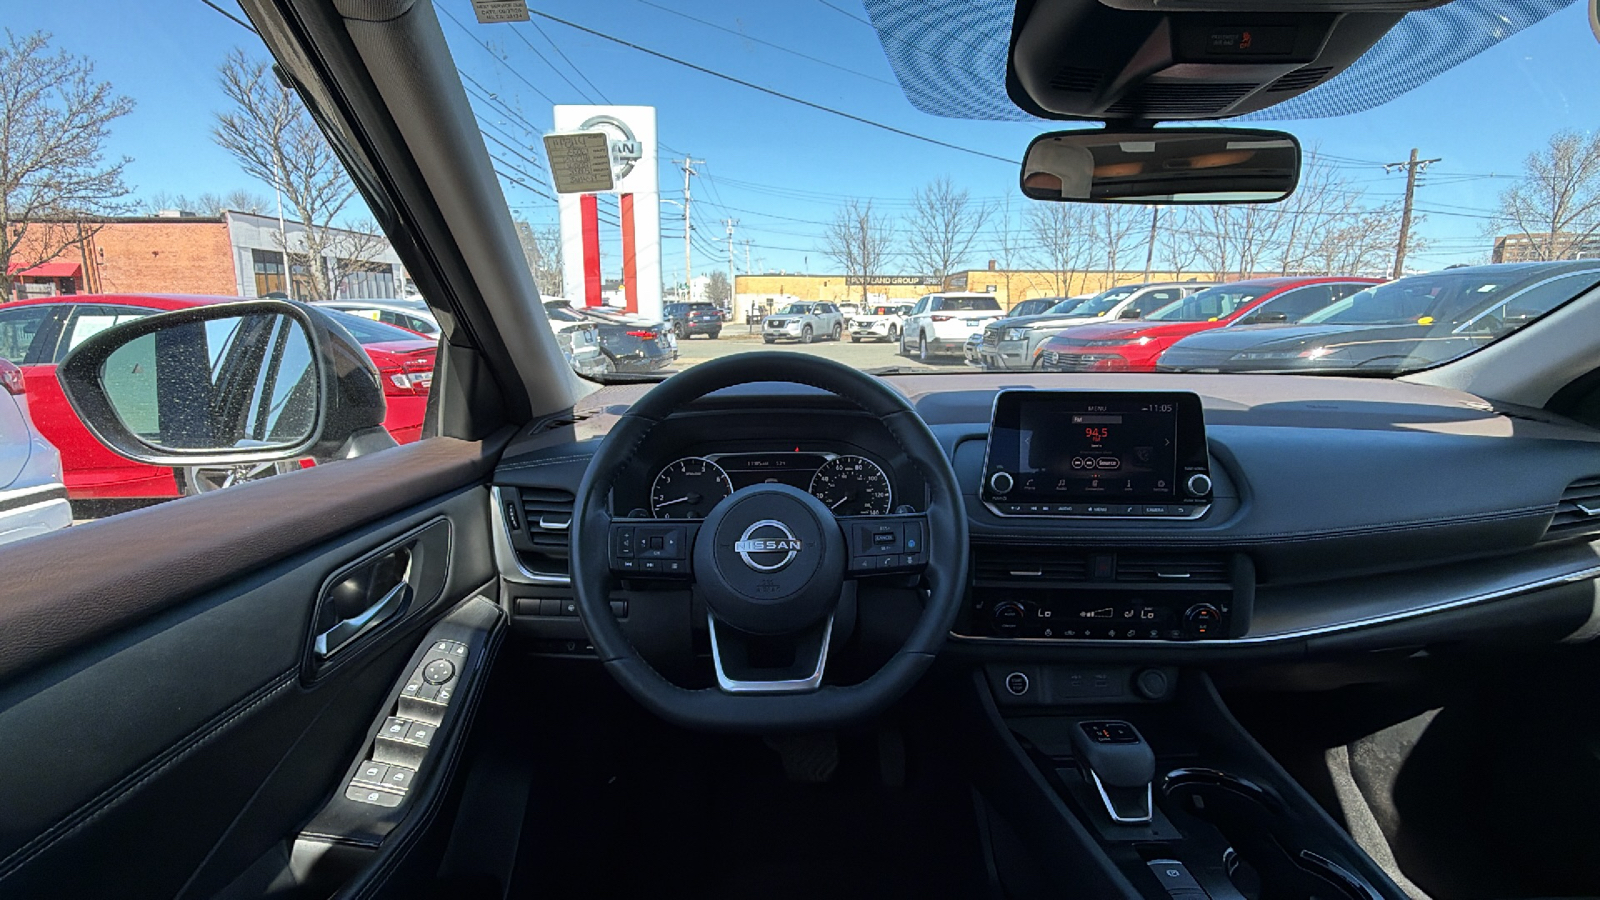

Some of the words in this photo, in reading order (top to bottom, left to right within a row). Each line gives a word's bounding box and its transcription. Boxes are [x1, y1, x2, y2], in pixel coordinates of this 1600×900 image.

[1149, 404, 1173, 412] 11:05
[1085, 427, 1108, 438] 94.5
[736, 541, 801, 551] NISSAN
[1037, 608, 1052, 618] Lo
[1140, 610, 1155, 619] Lo
